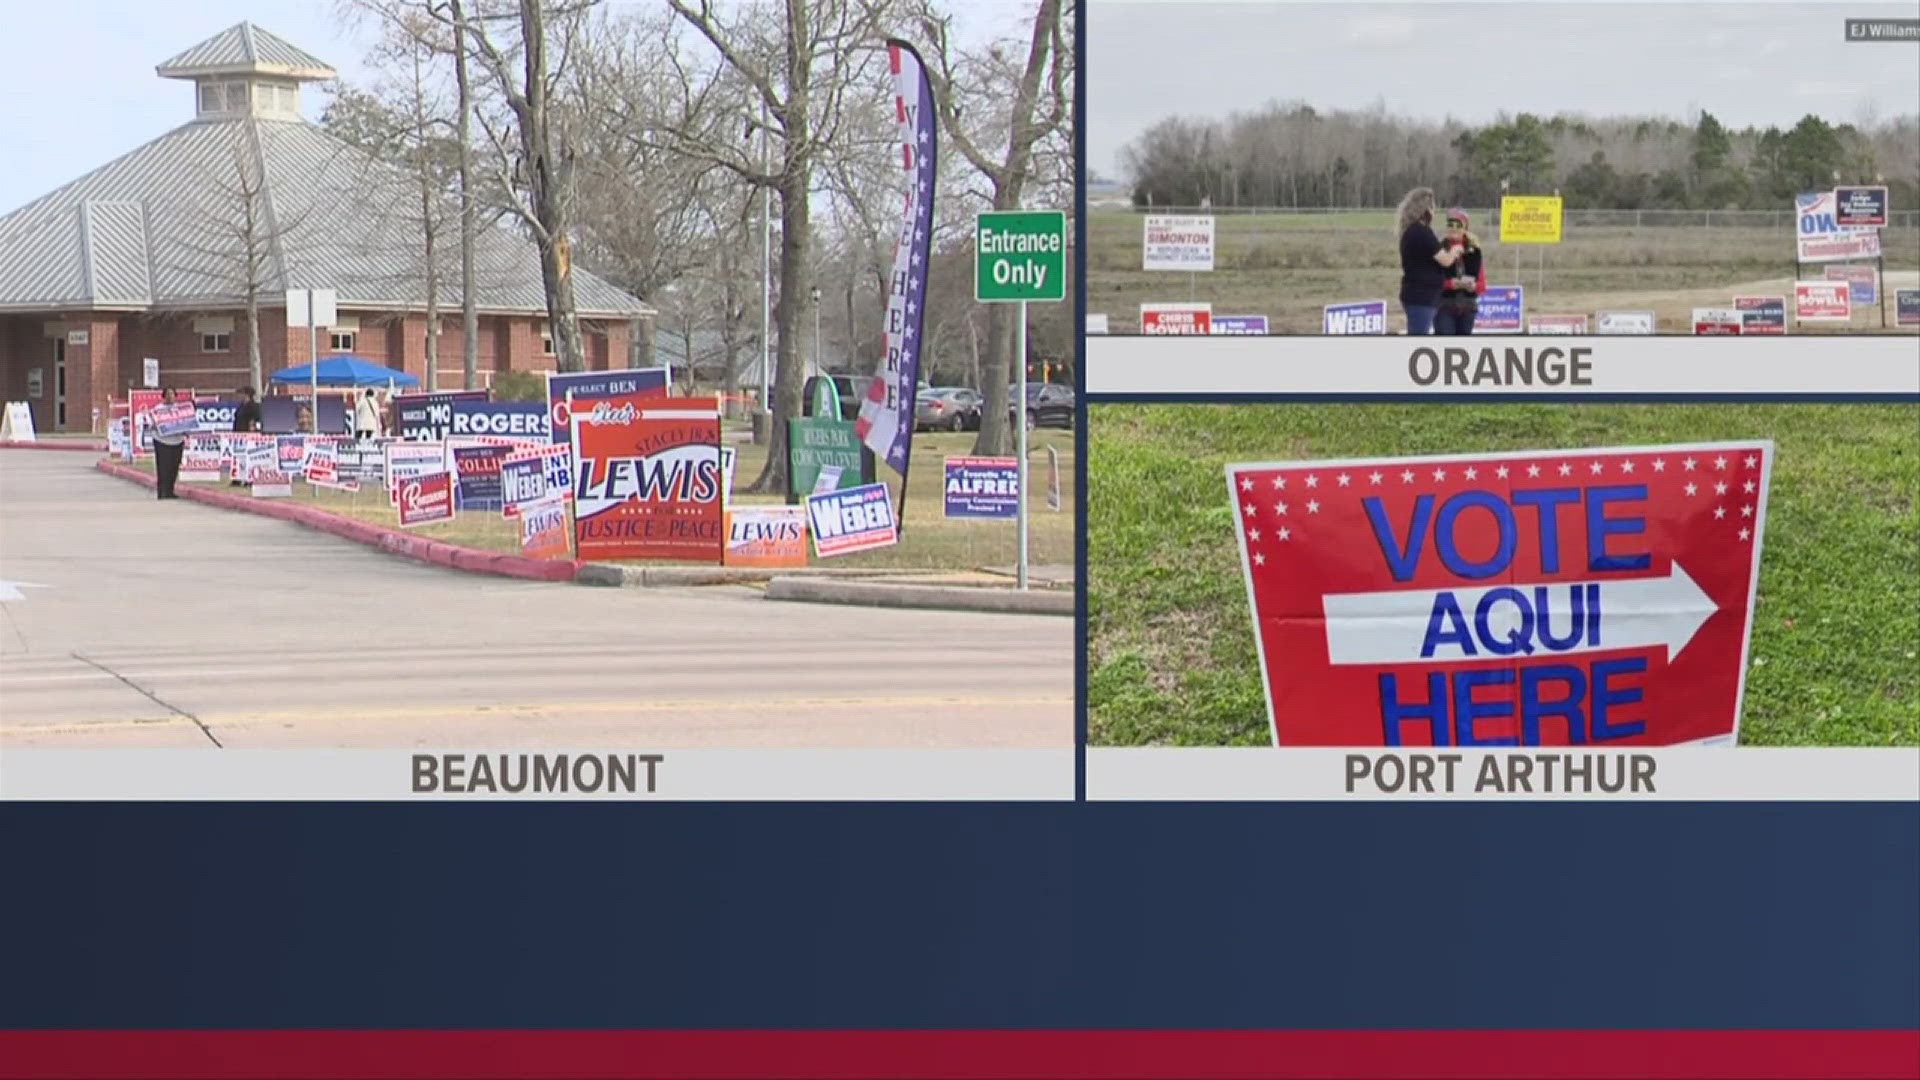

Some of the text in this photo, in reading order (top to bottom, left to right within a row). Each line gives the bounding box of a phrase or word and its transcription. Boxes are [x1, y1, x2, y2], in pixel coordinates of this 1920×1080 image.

[980, 228, 1060, 253] Entrance
[1147, 232, 1209, 245] SIMONTON
[993, 258, 1047, 289] Only
[1327, 310, 1382, 334] WEBER
[886, 270, 906, 411] HERE
[609, 380, 637, 394] BEN
[503, 465, 542, 503] WEBER
[577, 458, 719, 500] LEWIS
[580, 519, 653, 541] JUSTICE
[669, 519, 721, 539] PEACE
[730, 521, 801, 543] LEWIS
[811, 497, 892, 540] WEBER
[1361, 484, 1652, 582] VOTE
[1419, 583, 1601, 659] AQUI
[1377, 656, 1648, 748] HERE
